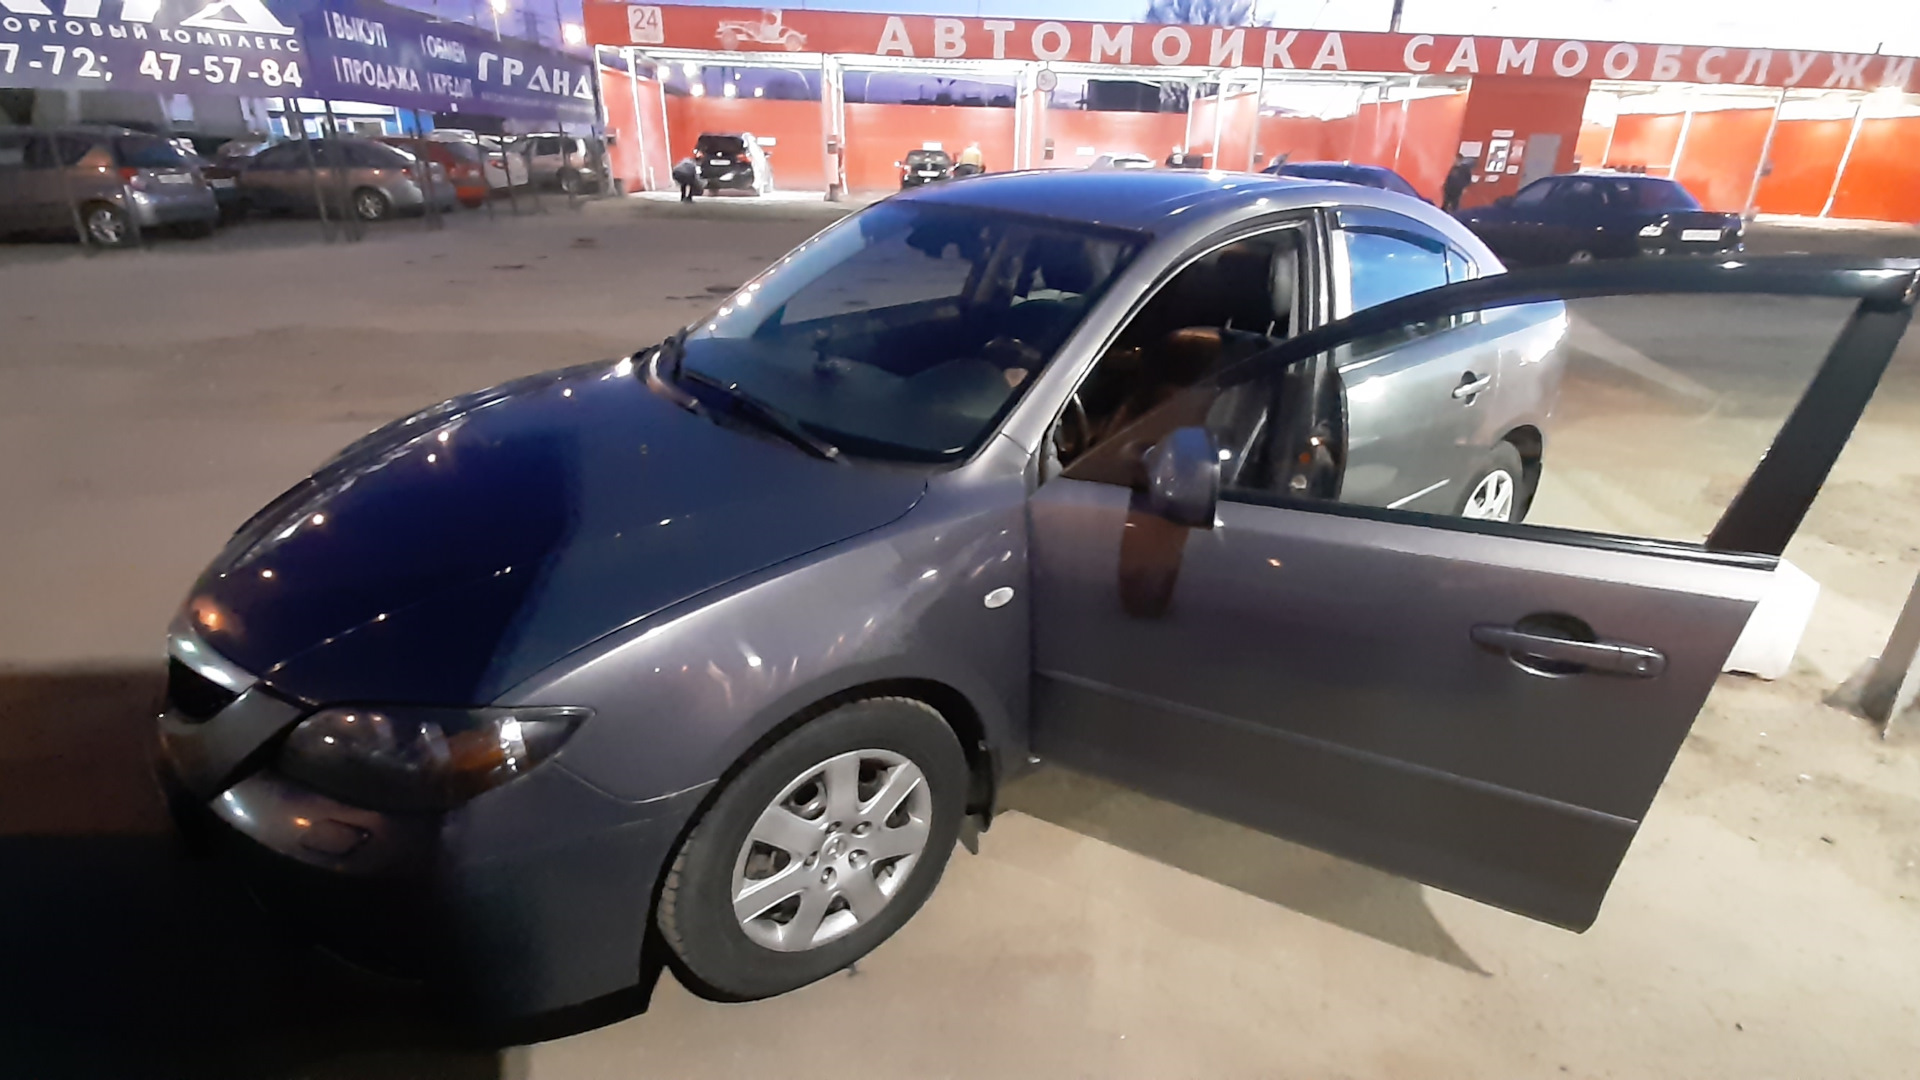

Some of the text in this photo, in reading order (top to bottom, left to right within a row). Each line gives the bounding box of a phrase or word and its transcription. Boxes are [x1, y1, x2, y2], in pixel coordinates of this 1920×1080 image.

[331, 11, 388, 48] ВЫКУП
[632, 7, 659, 31] 24
[159, 28, 300, 52] КОМПЛЕКС
[876, 16, 1914, 89] АВТОМОЙКА САМООБСЛУЖИ
[140, 50, 303, 88] 47-57-84
[341, 57, 421, 92] ПРОДАЖА
